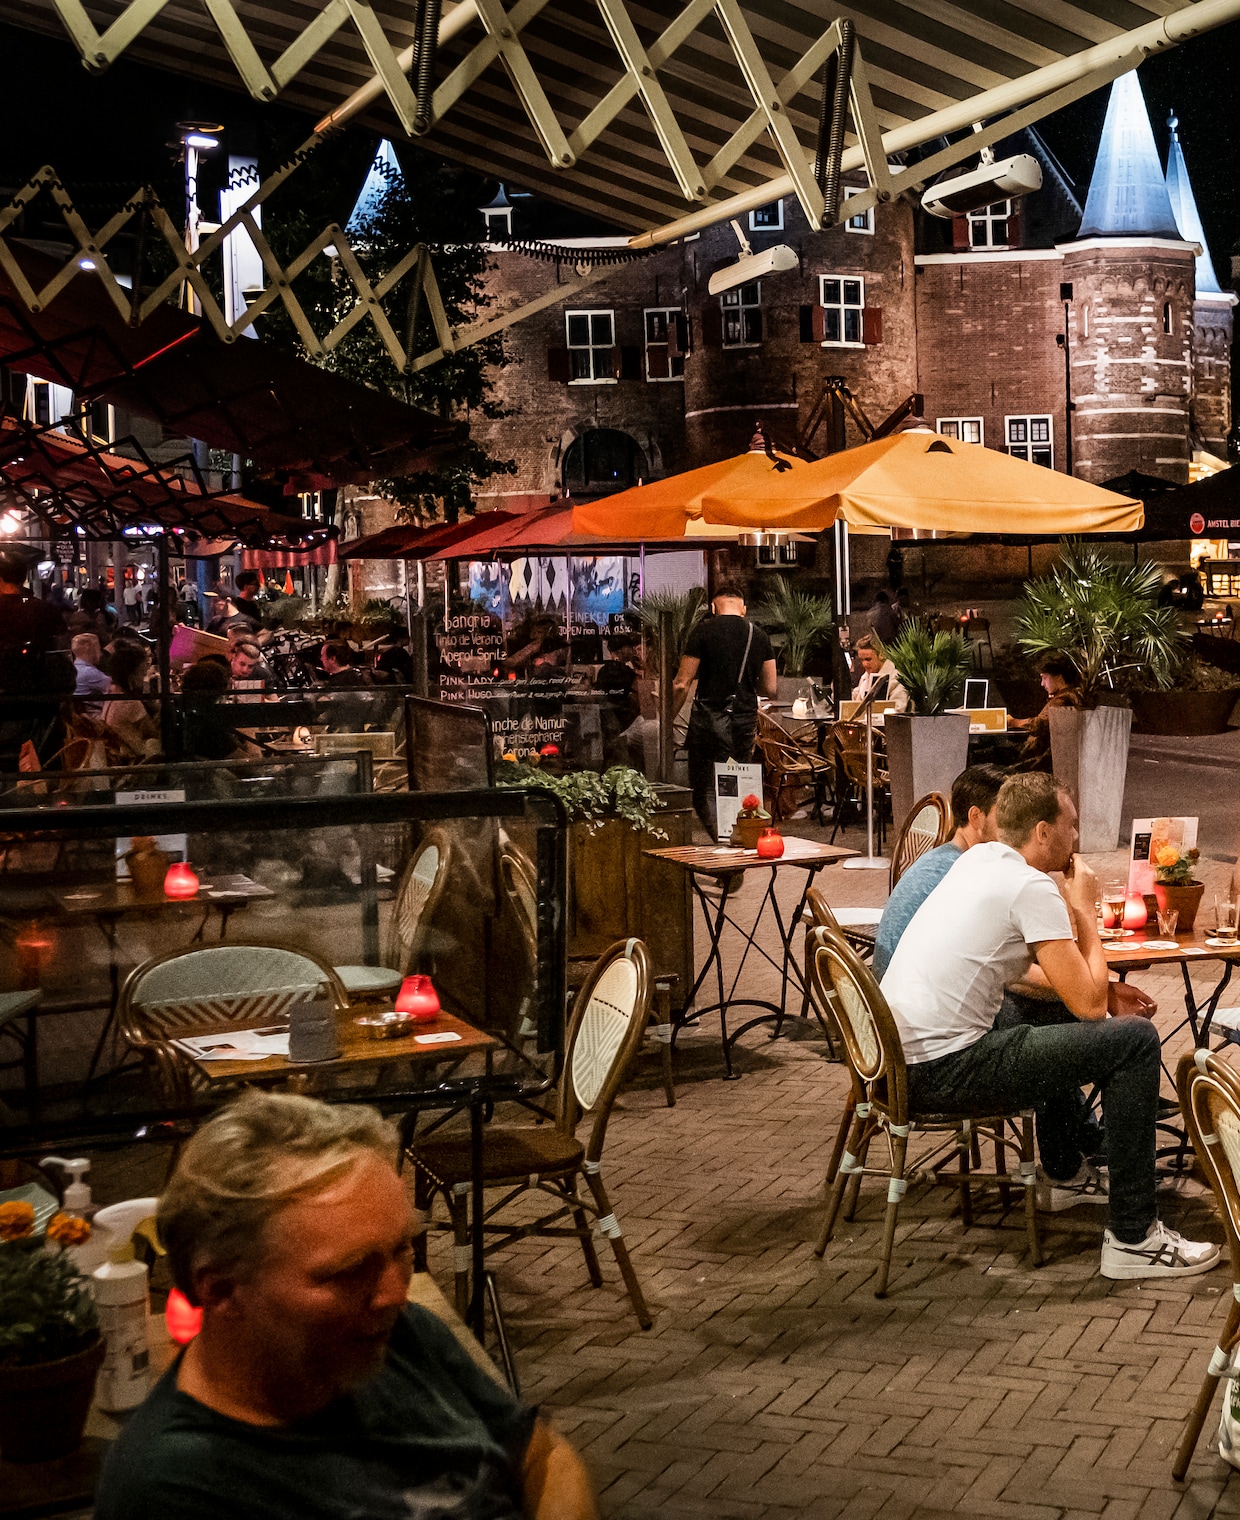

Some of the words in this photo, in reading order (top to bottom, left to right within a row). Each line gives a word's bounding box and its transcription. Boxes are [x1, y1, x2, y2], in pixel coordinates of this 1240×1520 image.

[1207, 519, 1229, 528] AMSTEL
[442, 615, 491, 632] Sangria
[562, 612, 610, 623] HEINEKEN
[439, 674, 465, 686] PINK
[467, 674, 494, 686] LADY
[440, 690, 465, 701] PINK
[467, 689, 492, 699] HUGO
